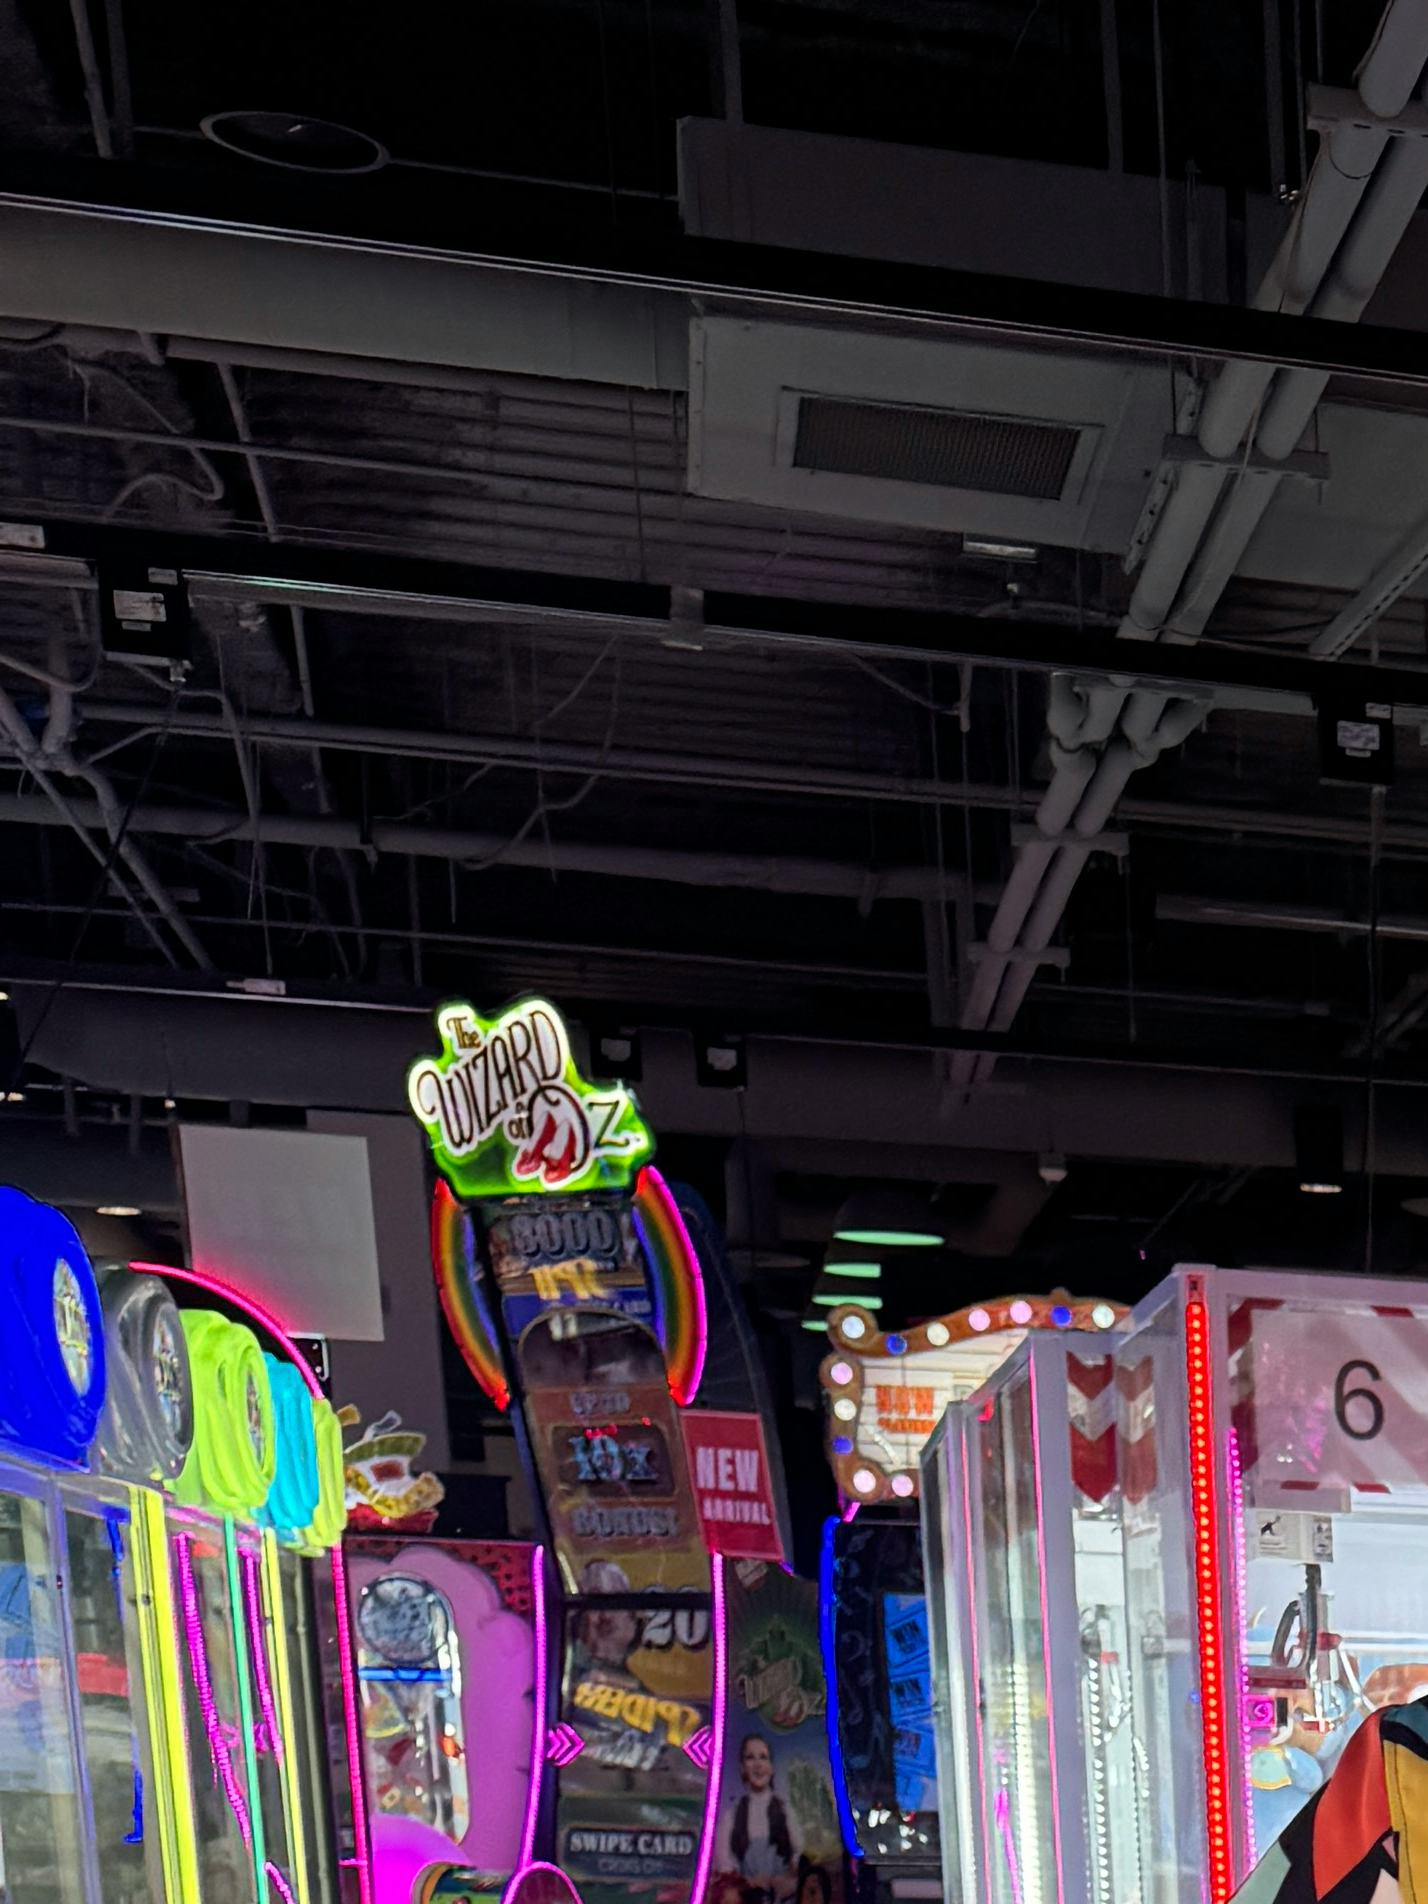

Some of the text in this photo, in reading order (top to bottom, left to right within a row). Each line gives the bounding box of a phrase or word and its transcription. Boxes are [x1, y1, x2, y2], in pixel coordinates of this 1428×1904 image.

[447, 1016, 483, 1050] The
[417, 1010, 564, 1149] WIZARD
[1332, 1360, 1385, 1441] 6
[696, 1447, 759, 1493] NEW
[703, 1498, 771, 1526] ARRIVAL
[570, 1831, 693, 1855] SWIPE CARD
